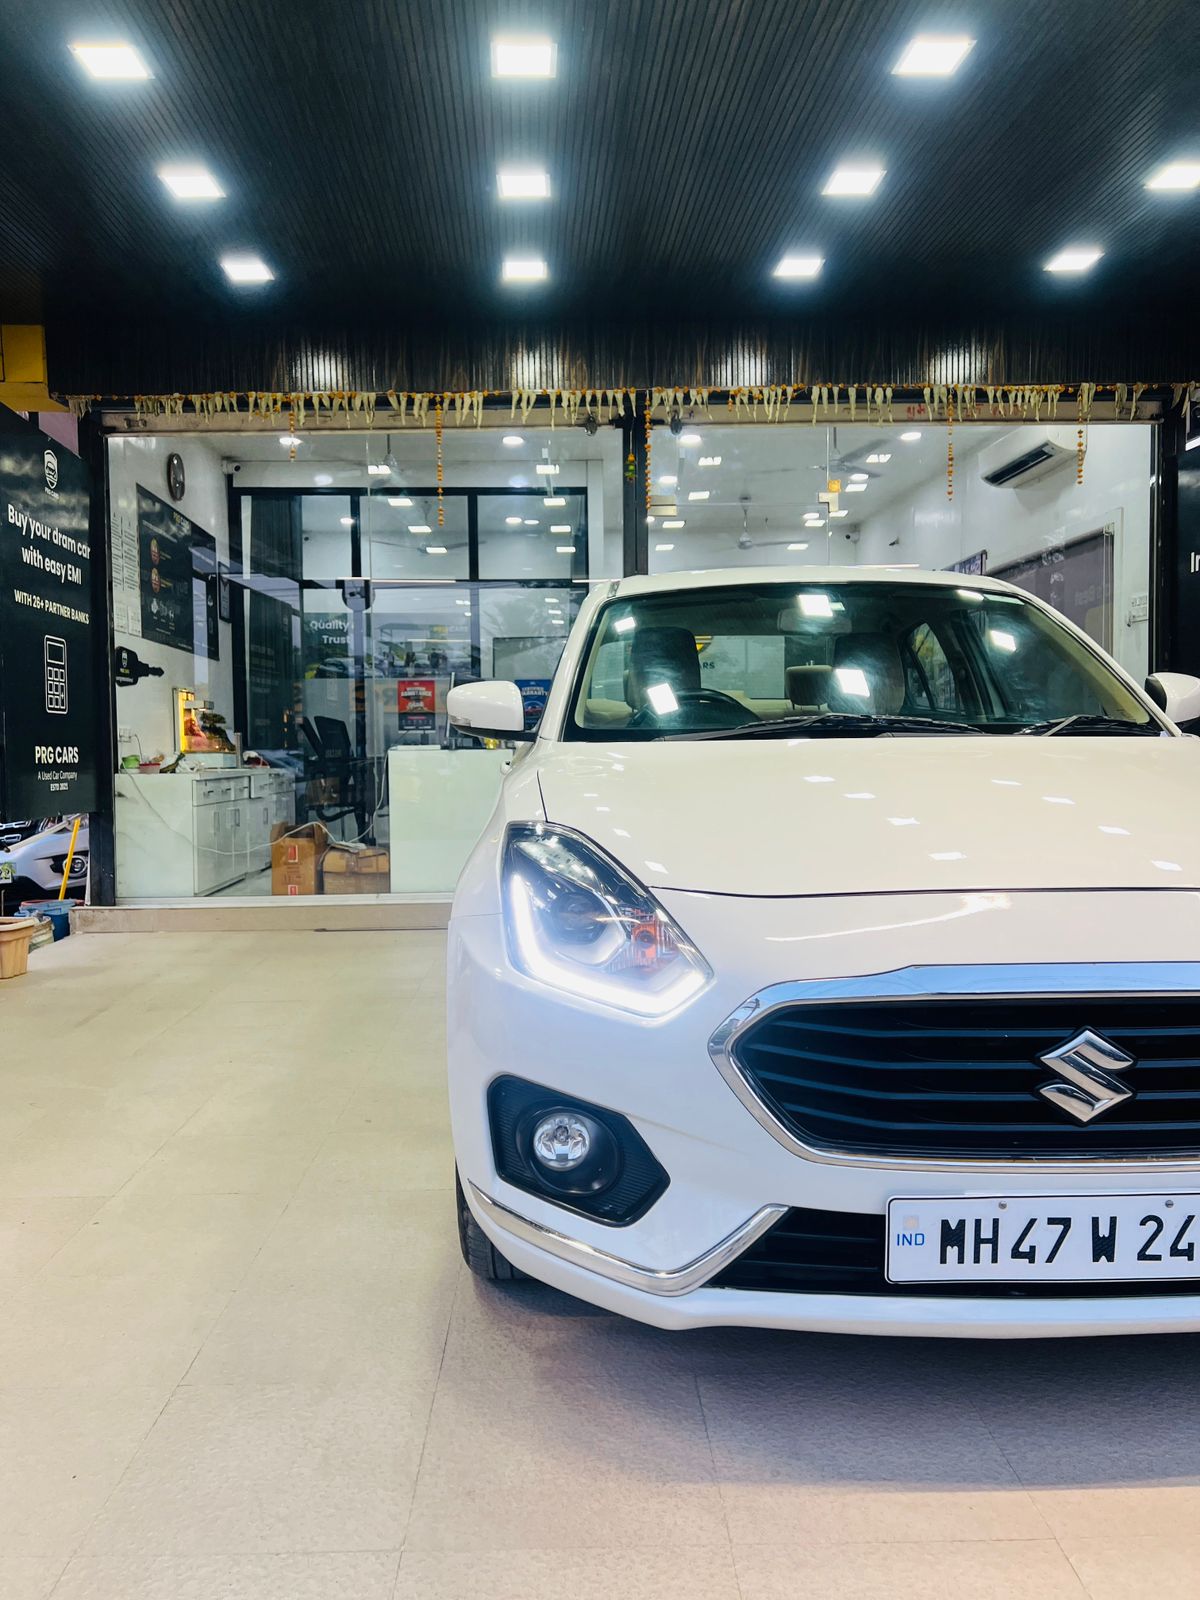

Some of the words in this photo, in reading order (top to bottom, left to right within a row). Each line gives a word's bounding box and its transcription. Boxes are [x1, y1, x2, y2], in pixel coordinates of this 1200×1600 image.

[7, 503, 28, 536] Buy
[28, 517, 52, 540] your
[52, 527, 77, 554] dram
[77, 541, 91, 560] car
[21, 545, 43, 570] with
[44, 557, 66, 584] easy
[67, 563, 82, 585] EMI
[13, 588, 33, 607] WITH
[32, 595, 45, 611] 26+
[44, 599, 71, 617] PARTNER
[71, 608, 90, 625] BANKS
[309, 619, 349, 633] Quality
[322, 635, 351, 645] Trust
[34, 745, 54, 764] PRG
[55, 745, 79, 764] CARS
[37, 771, 42, 781] A
[42, 771, 53, 781] Used
[52, 770, 60, 780] Car
[60, 770, 78, 781] Company
[896, 1232, 926, 1247] IND
[939, 1217, 1000, 1265] MH
[1010, 1216, 1072, 1265] 47
[1090, 1215, 1118, 1263] W
[1136, 1213, 1196, 1262] 24
